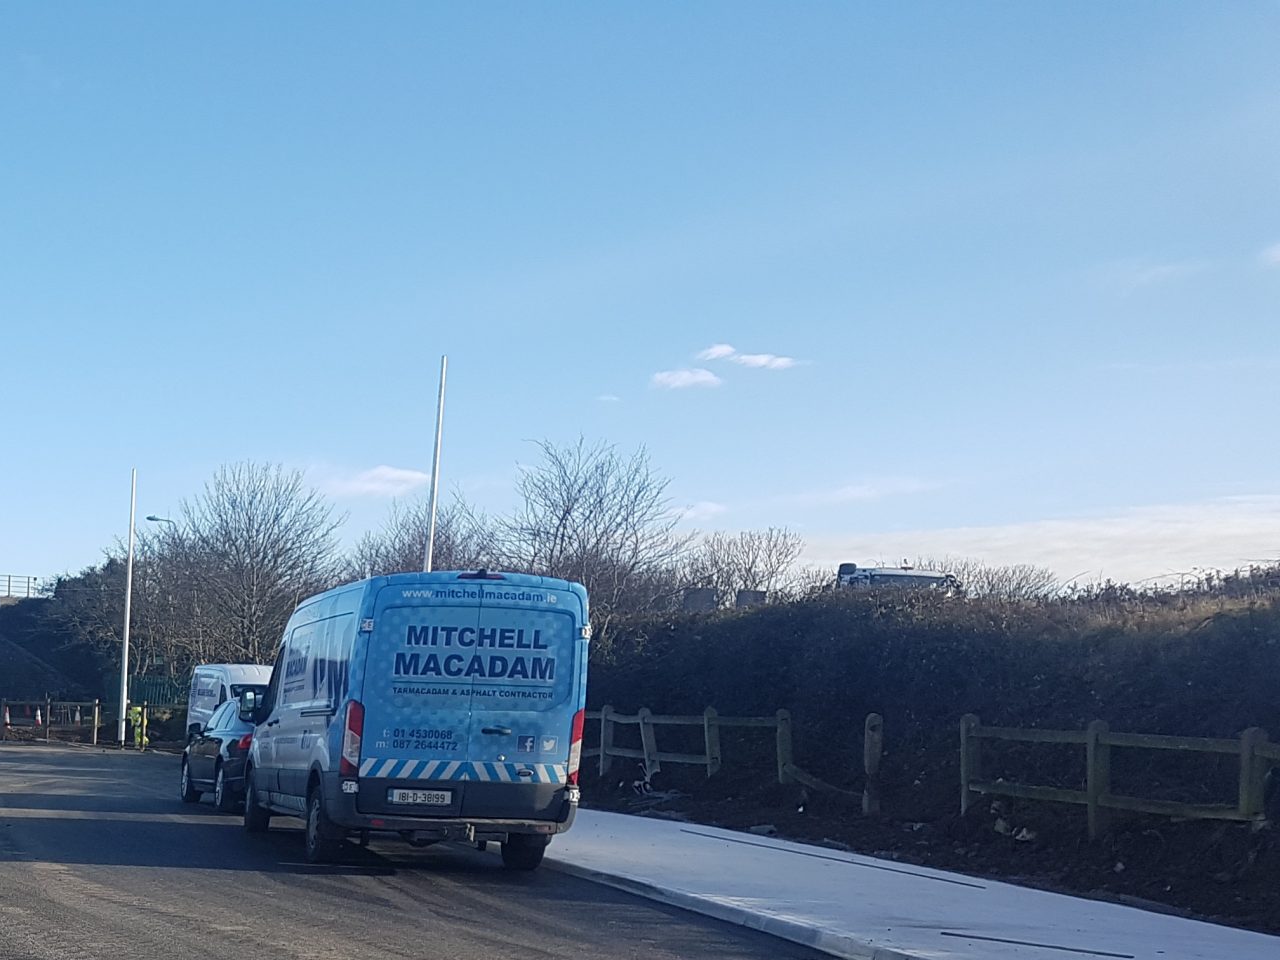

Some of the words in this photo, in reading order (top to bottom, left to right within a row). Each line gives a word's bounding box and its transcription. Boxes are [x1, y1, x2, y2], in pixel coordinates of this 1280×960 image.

[402, 588, 556, 602] www.mitchellmacadam.ie
[406, 625, 549, 650] MITCHELL
[393, 652, 556, 680] MACADAM
[392, 686, 449, 695] TARMACADAM
[451, 688, 458, 696] &
[460, 688, 496, 697] ASPHALT
[499, 690, 553, 699] CONTRACTOR
[393, 728, 405, 738] 01
[409, 729, 453, 740] 4530068
[392, 740, 411, 749] 087
[414, 740, 458, 751] 2644472
[398, 791, 446, 803] 181-D-38199
